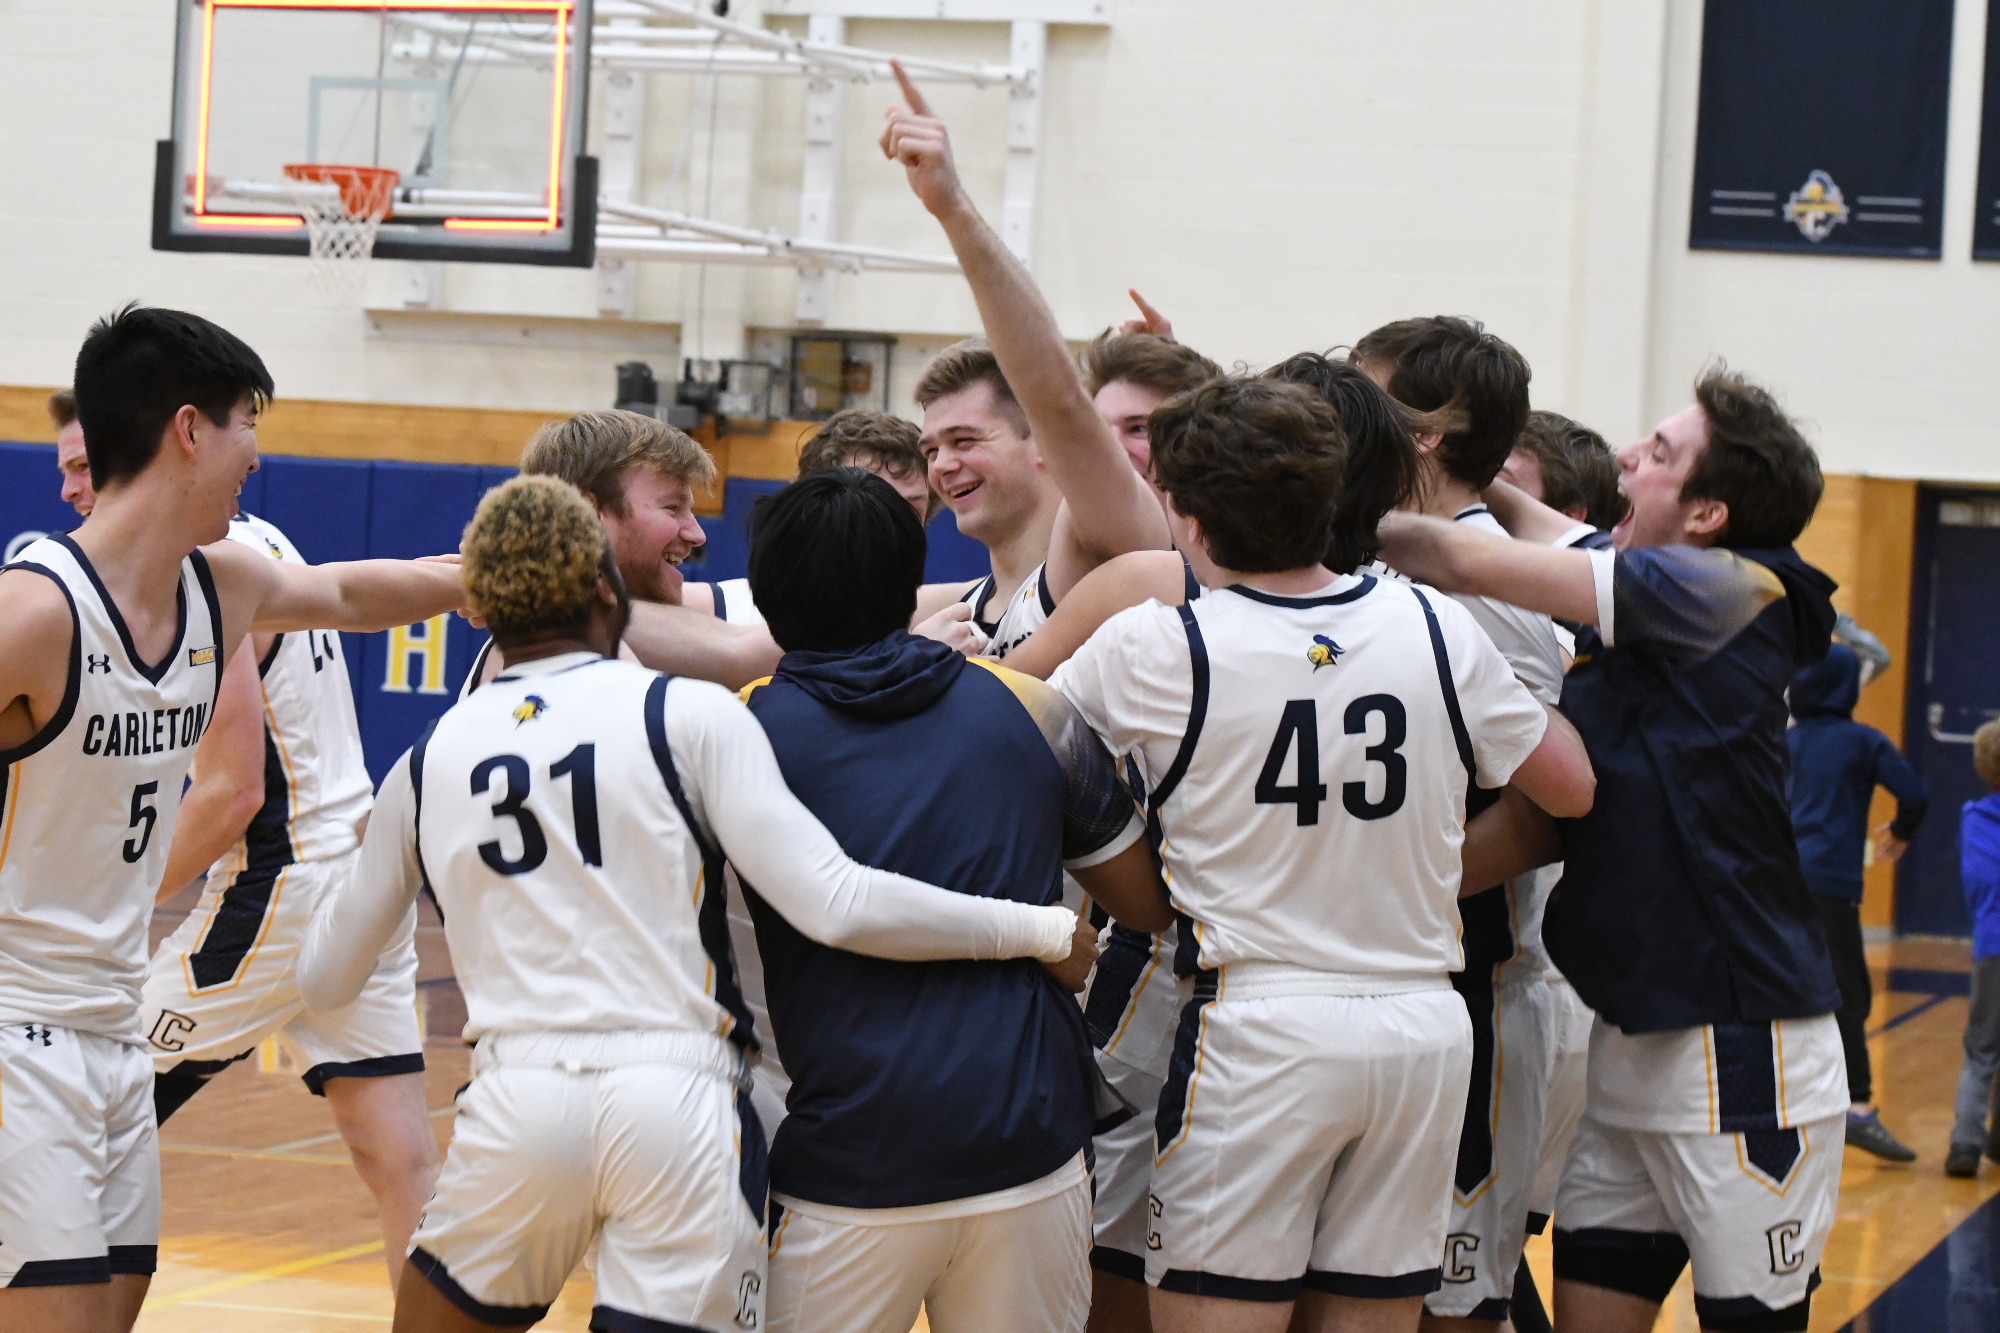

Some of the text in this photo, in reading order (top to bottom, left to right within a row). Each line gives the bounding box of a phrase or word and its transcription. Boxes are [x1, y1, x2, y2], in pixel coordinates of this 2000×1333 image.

[83, 702, 208, 757] CARLETON
[1255, 693, 1408, 827] 43
[123, 780, 158, 864] 5
[469, 743, 604, 877] 31
[148, 1009, 197, 1053] C
[1441, 1232, 1481, 1284] C
[1766, 1220, 1804, 1276] C
[734, 1270, 761, 1330] C
